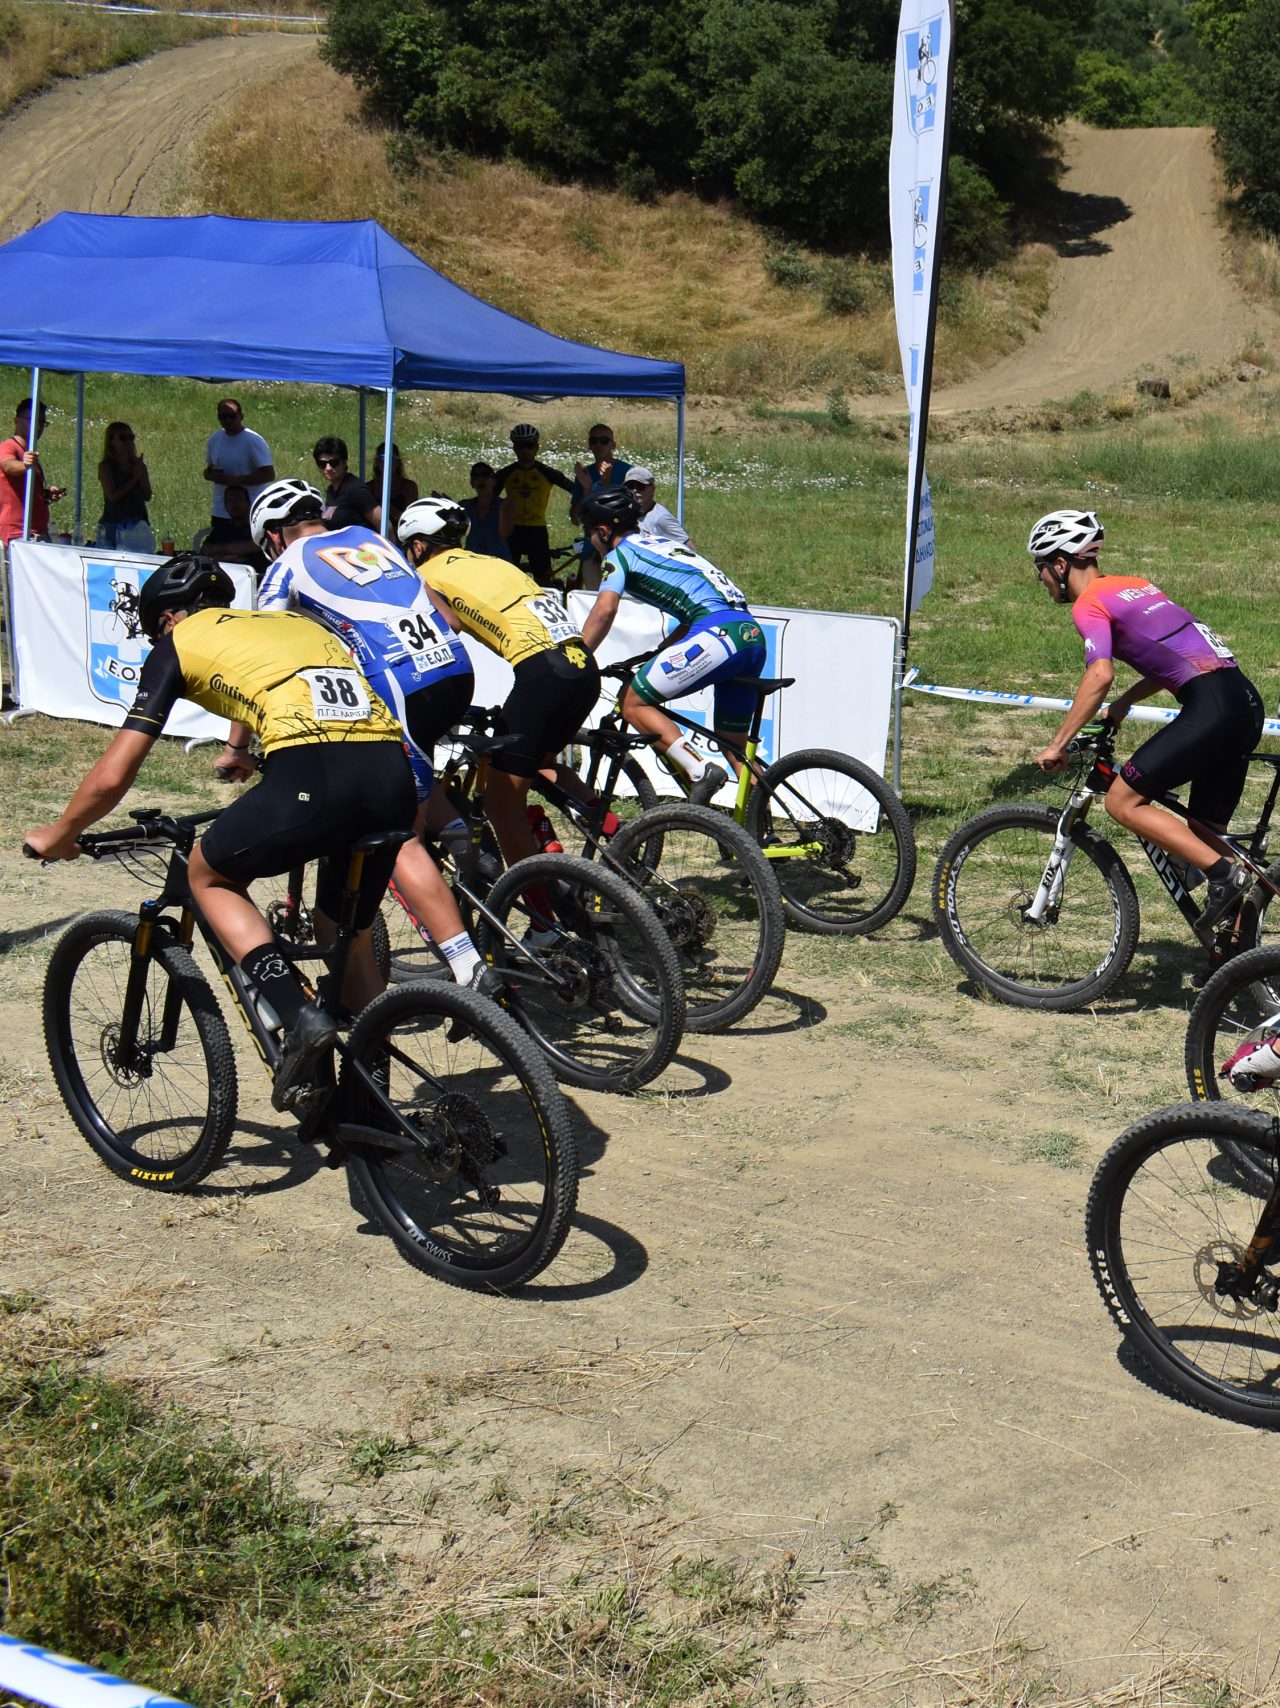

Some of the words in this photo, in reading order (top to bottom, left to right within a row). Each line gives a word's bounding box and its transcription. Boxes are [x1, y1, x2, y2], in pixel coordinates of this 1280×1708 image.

[452, 596, 507, 644] Continental
[533, 598, 568, 624] 33
[399, 613, 439, 650] 34
[315, 675, 359, 707] 38
[1042, 864, 1058, 888] FOX
[947, 845, 969, 945] REYNOLDS
[131, 1168, 175, 1181] MAXXIS
[407, 1225, 426, 1243] DT
[426, 1241, 453, 1263] SWISS
[1096, 1250, 1131, 1324] MAXXIS
